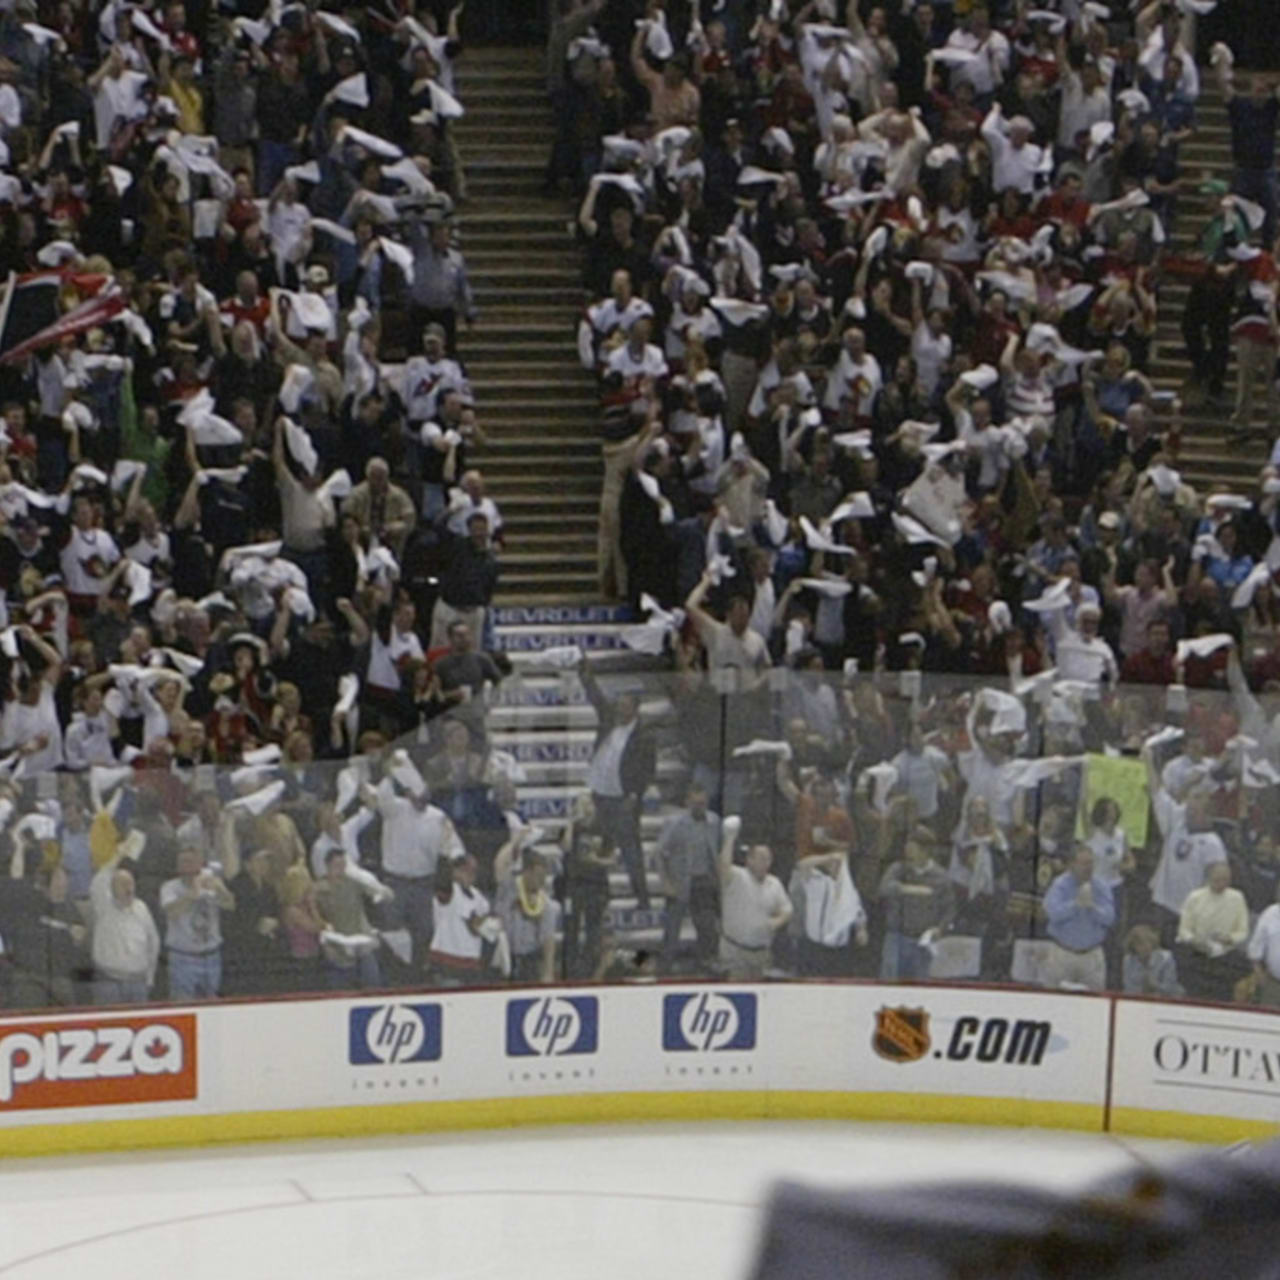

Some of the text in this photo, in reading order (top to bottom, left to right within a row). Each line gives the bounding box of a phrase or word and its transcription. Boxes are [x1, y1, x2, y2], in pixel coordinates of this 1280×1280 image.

[488, 606, 616, 624] HEVROLET
[376, 1005, 416, 1064] hp
[533, 997, 573, 1056] hp
[690, 993, 730, 1051] hp
